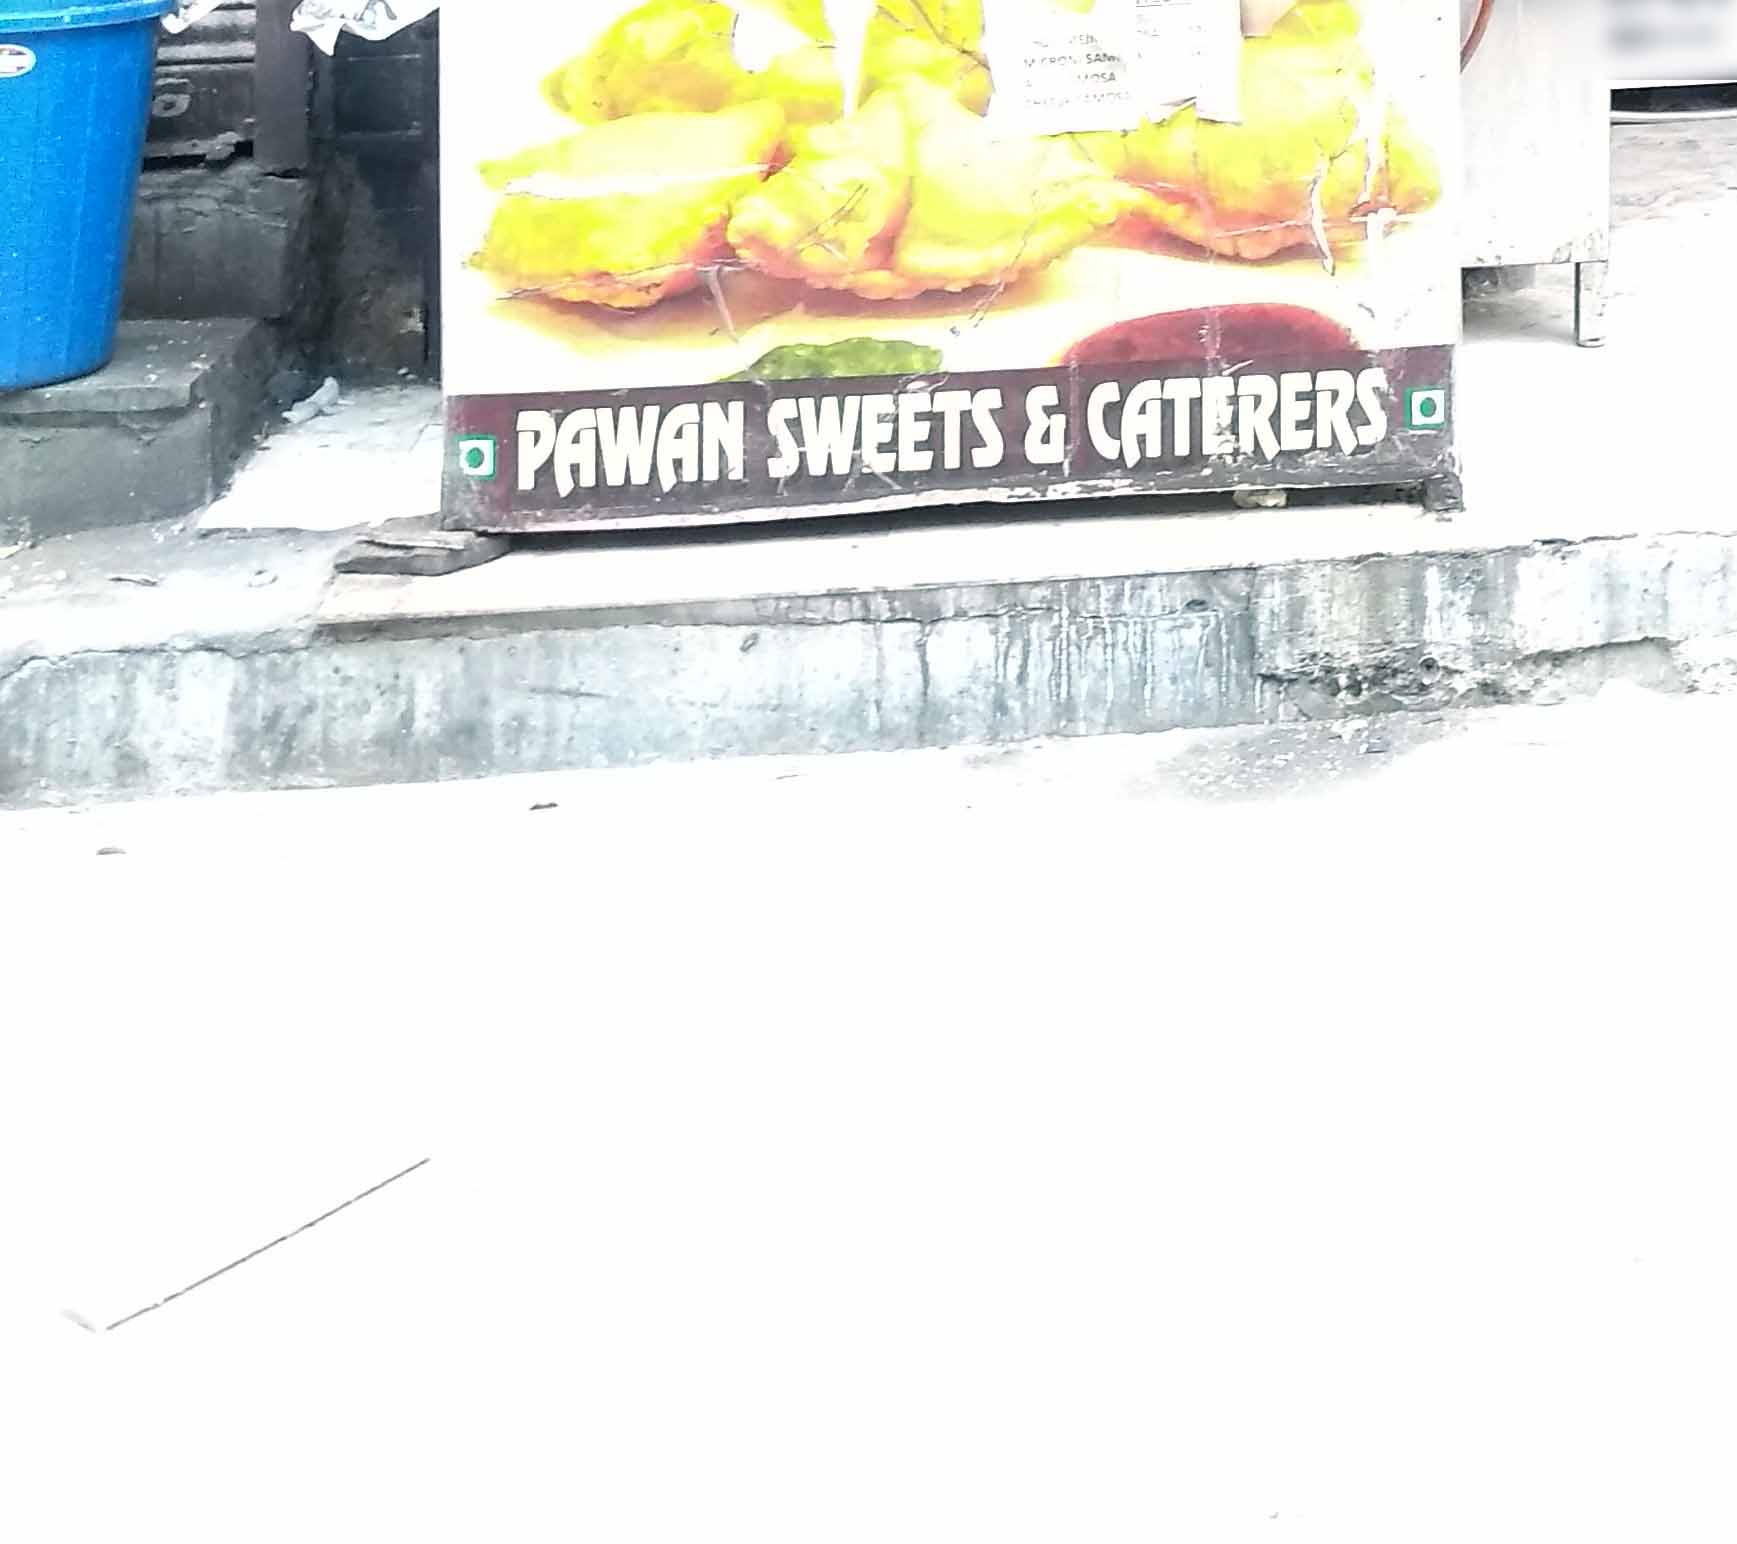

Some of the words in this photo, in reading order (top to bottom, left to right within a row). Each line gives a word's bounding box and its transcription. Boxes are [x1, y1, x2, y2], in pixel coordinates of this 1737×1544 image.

[516, 398, 745, 497] PAWAN
[769, 387, 1007, 481] SWEETS
[1023, 385, 1067, 464] &
[1086, 368, 1389, 464] CATERERS
